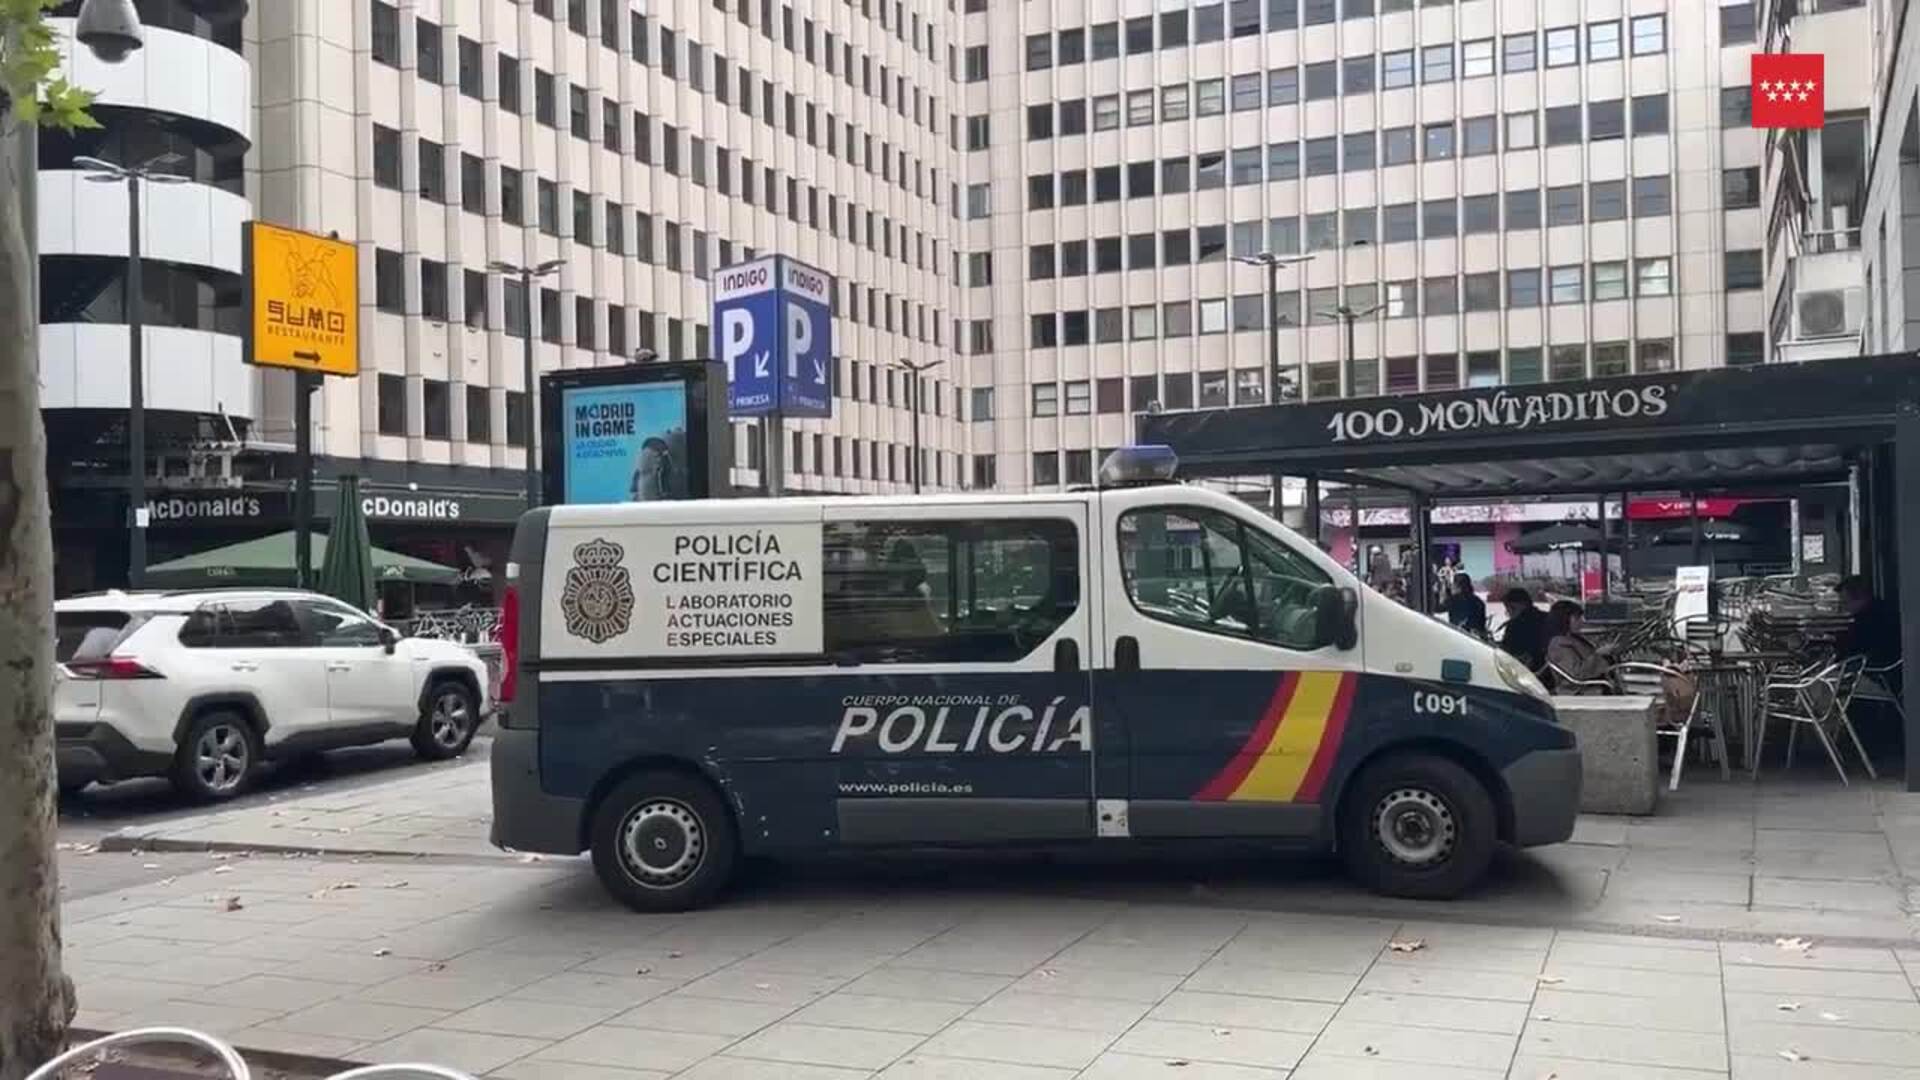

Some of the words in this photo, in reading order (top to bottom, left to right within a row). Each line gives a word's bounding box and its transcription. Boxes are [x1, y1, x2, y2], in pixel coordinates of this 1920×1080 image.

[723, 267, 767, 291] INDIGO
[788, 267, 823, 296] INDIGO
[267, 299, 345, 334] SUMO
[267, 324, 345, 346] RESTAURANTE
[722, 308, 754, 382] P
[787, 301, 812, 378] P
[1326, 408, 1403, 442] 100
[1409, 384, 1668, 435] MONTADITOS
[575, 421, 590, 438] IN
[592, 420, 636, 437] GAME
[362, 497, 459, 518] cDonald's
[675, 530, 781, 556] POLICÍA
[653, 557, 803, 583] CIENTÍFICA
[667, 612, 793, 629] ACTUACIONES
[667, 632, 777, 648] ESPECIALES
[842, 694, 910, 707] CUERPO
[912, 694, 993, 706] NACIONAL
[997, 694, 1020, 706] DE
[1426, 693, 1467, 715] 091
[830, 696, 1092, 752] POLICÍA
[838, 782, 973, 795] www.policia.es
